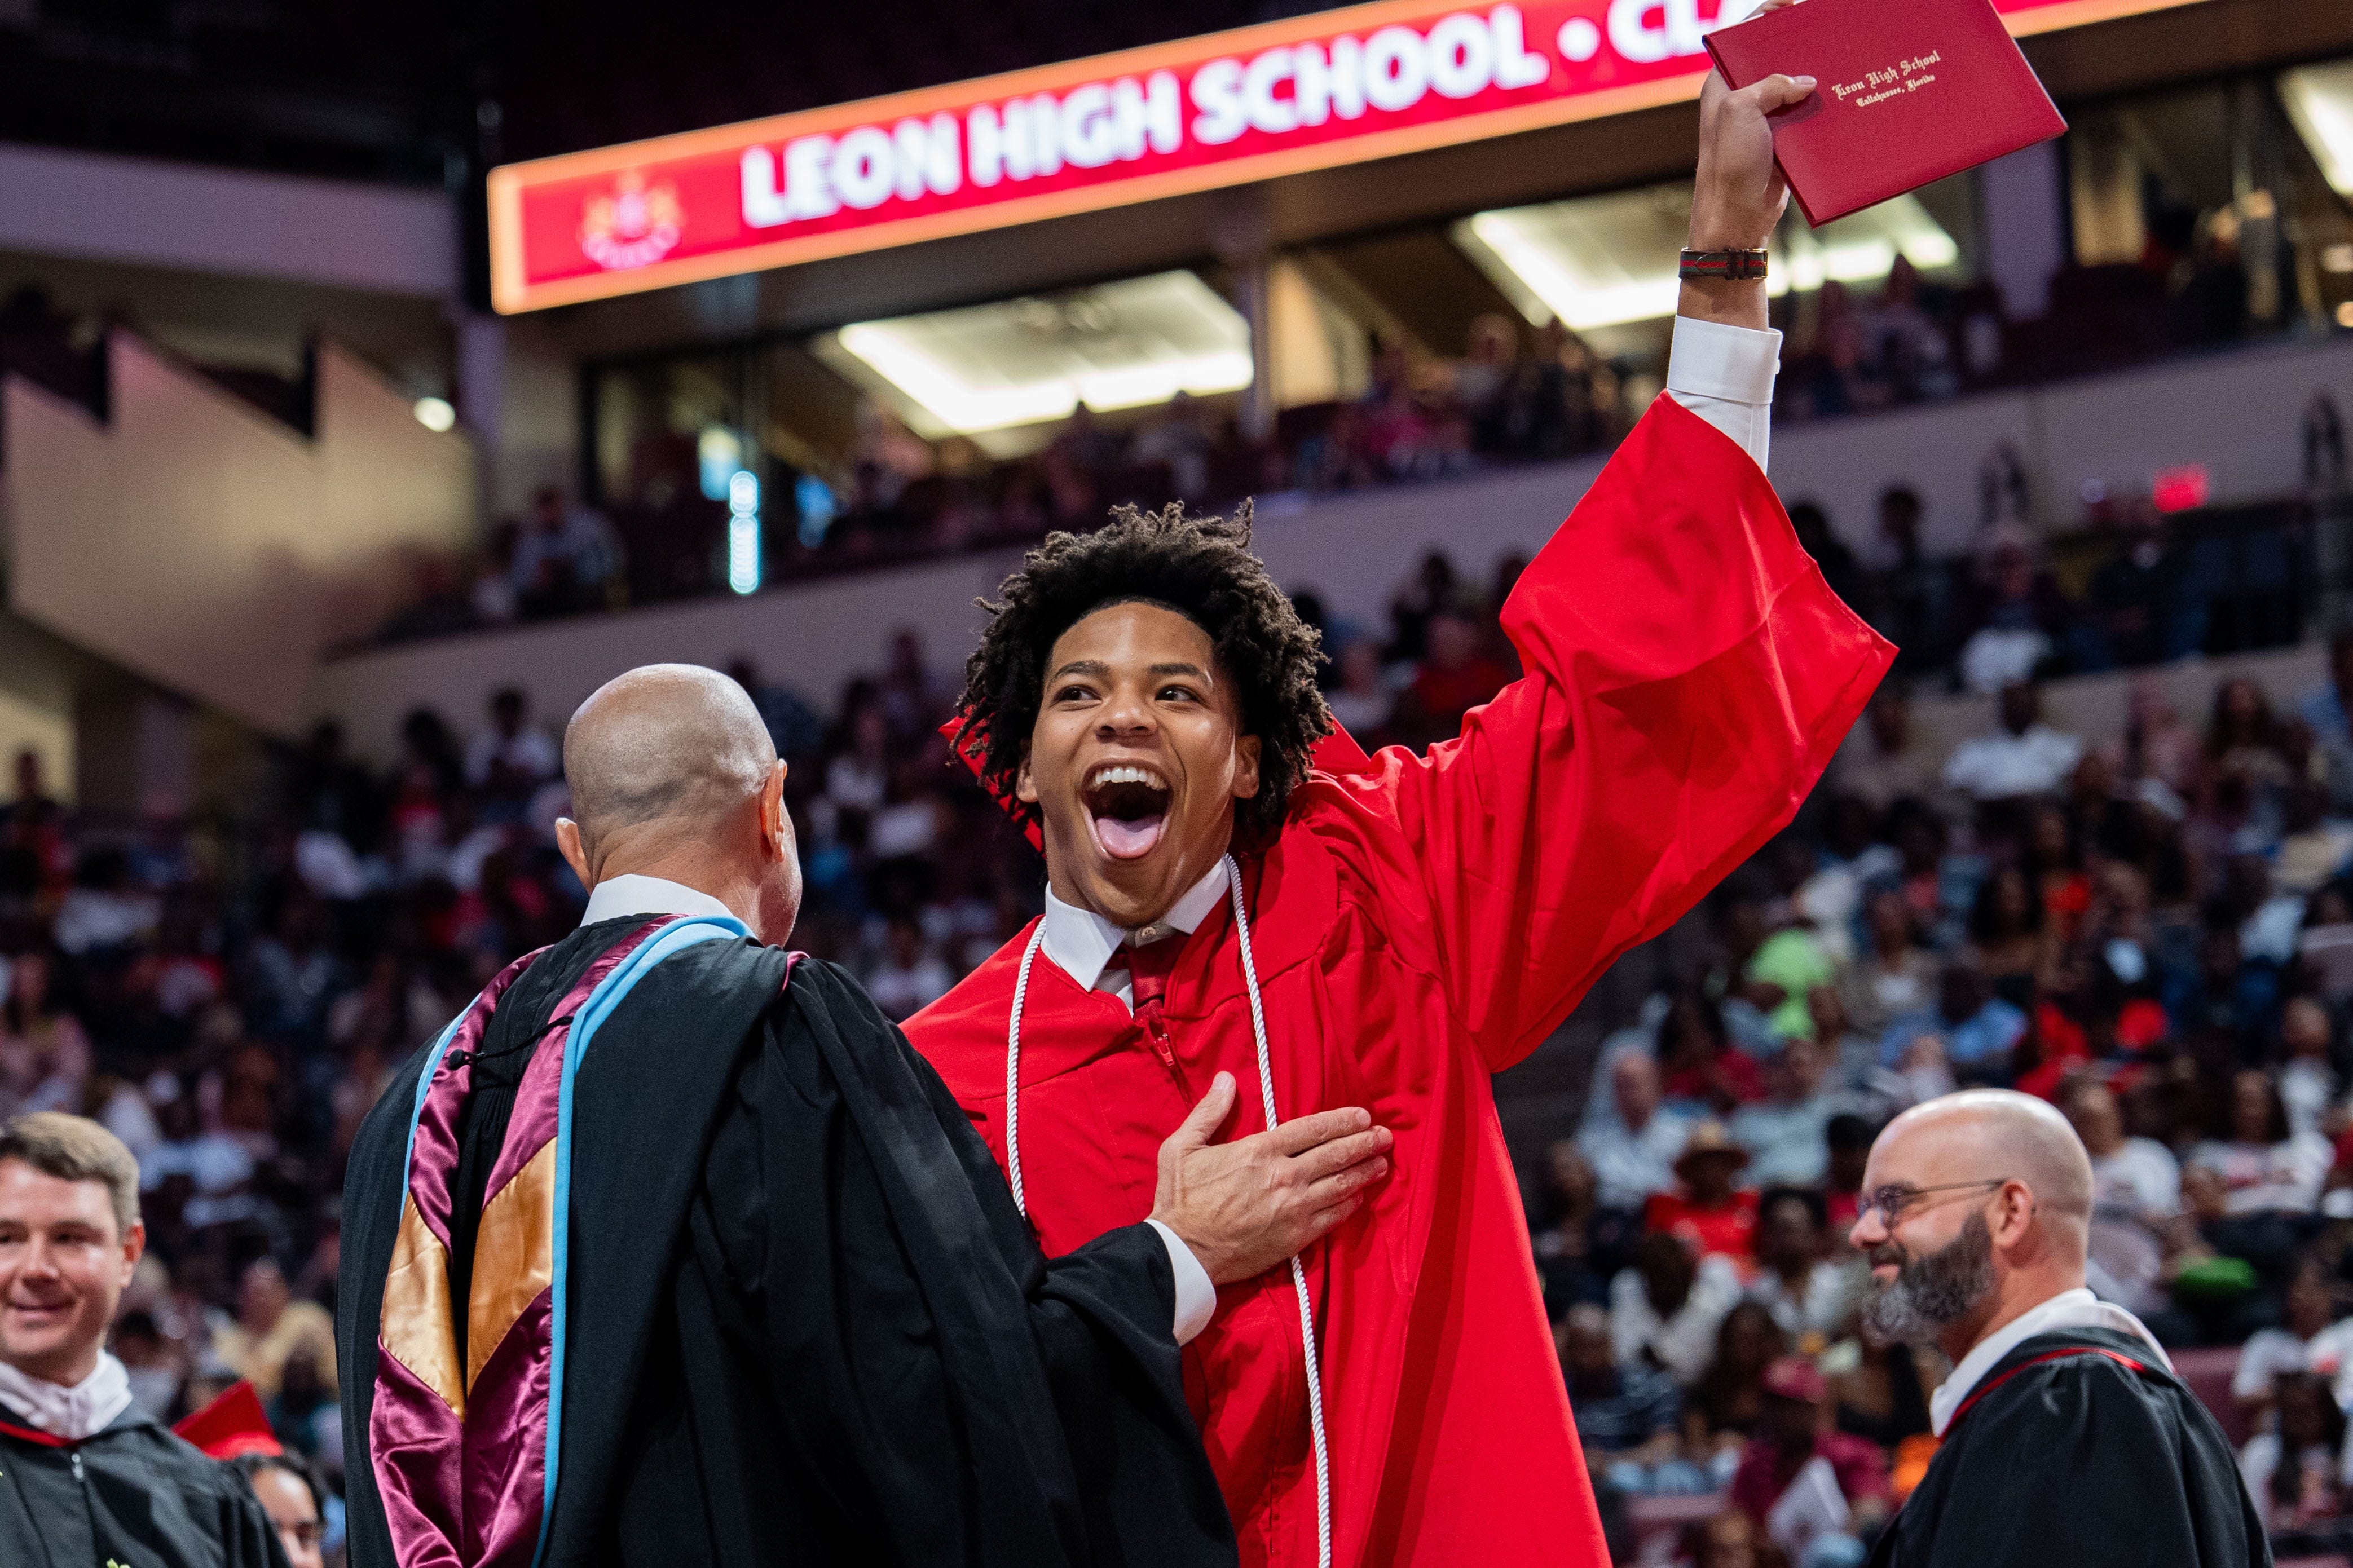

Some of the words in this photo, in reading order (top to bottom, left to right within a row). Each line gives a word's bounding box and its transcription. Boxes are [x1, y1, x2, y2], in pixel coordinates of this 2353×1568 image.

[1832, 81, 1865, 100] Leon
[1866, 66, 1899, 89] High
[1900, 50, 1941, 76] School
[1906, 74, 1936, 92] Florida
[740, 113, 962, 229] LEON
[966, 70, 1183, 187] HIGH
[1190, 3, 1549, 145] SCHOOL
